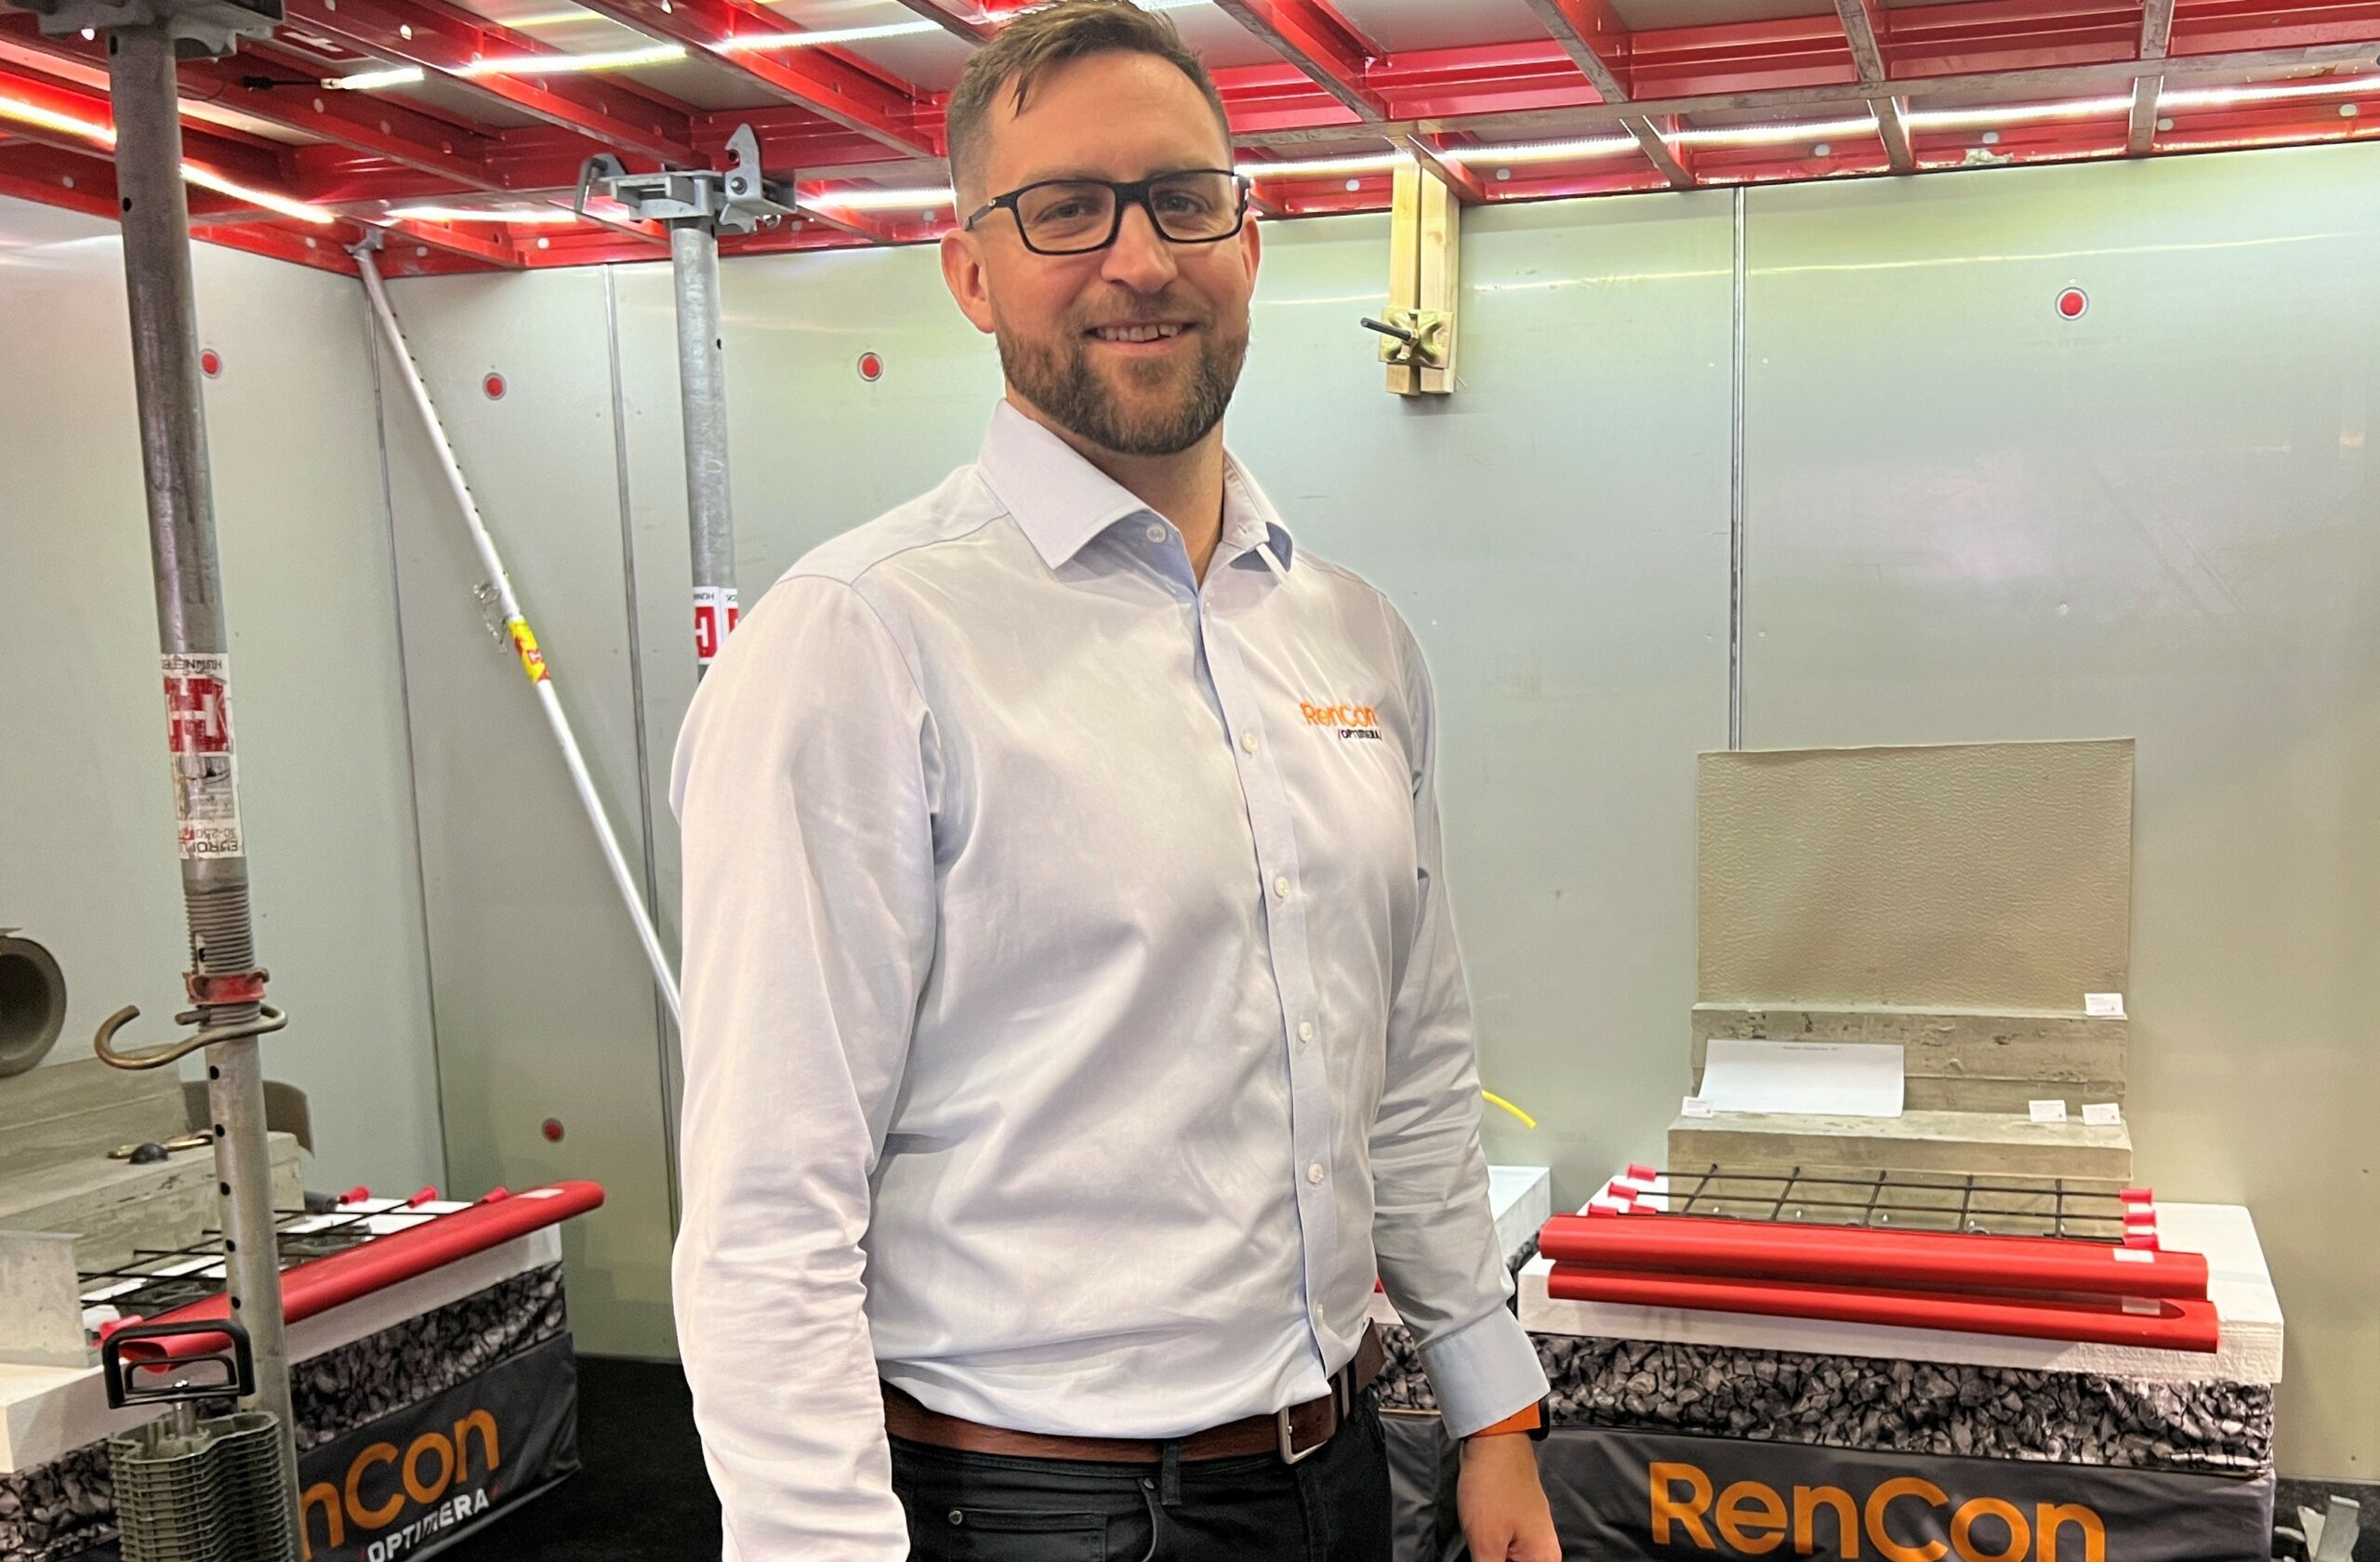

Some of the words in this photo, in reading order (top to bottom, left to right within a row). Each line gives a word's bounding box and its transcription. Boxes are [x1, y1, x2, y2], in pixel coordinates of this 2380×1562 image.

[1300, 701, 1379, 727] RenCon
[299, 1408, 500, 1562] nCon
[367, 1488, 490, 1562] OPTIMERA
[1648, 1461, 2106, 1562] RenCon
